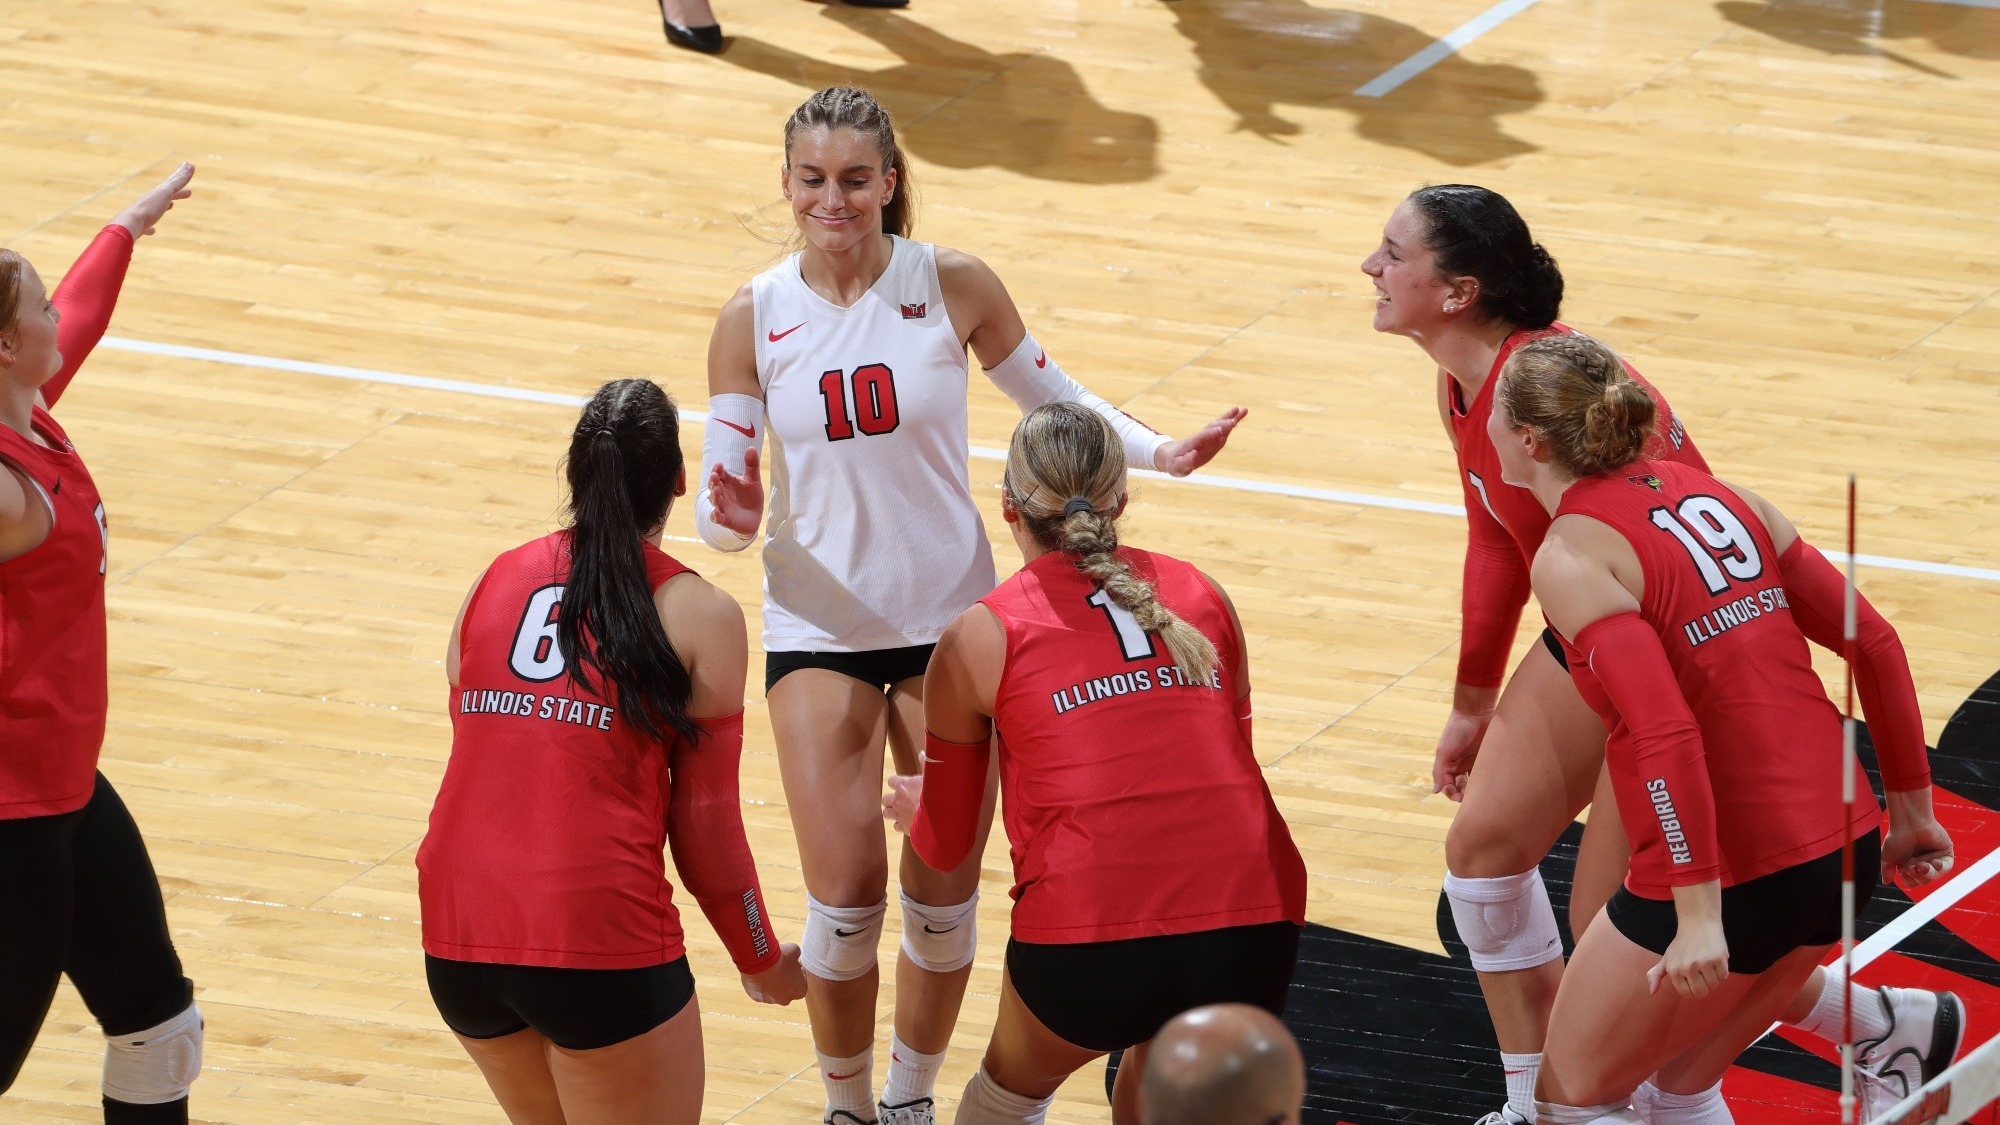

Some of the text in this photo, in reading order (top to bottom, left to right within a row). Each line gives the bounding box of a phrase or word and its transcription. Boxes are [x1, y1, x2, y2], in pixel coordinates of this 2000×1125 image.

[819, 363, 900, 442] 10
[1648, 494, 1763, 598] 19
[508, 582, 570, 683] 6
[1682, 595, 1761, 647] ILLINOIS
[460, 688, 615, 731] ILLINOIS STATE
[1051, 665, 1223, 715] ILLINOIS STE
[1646, 778, 1693, 865] REDBIRDS
[742, 887, 769, 958] ILLINOIS STATE
